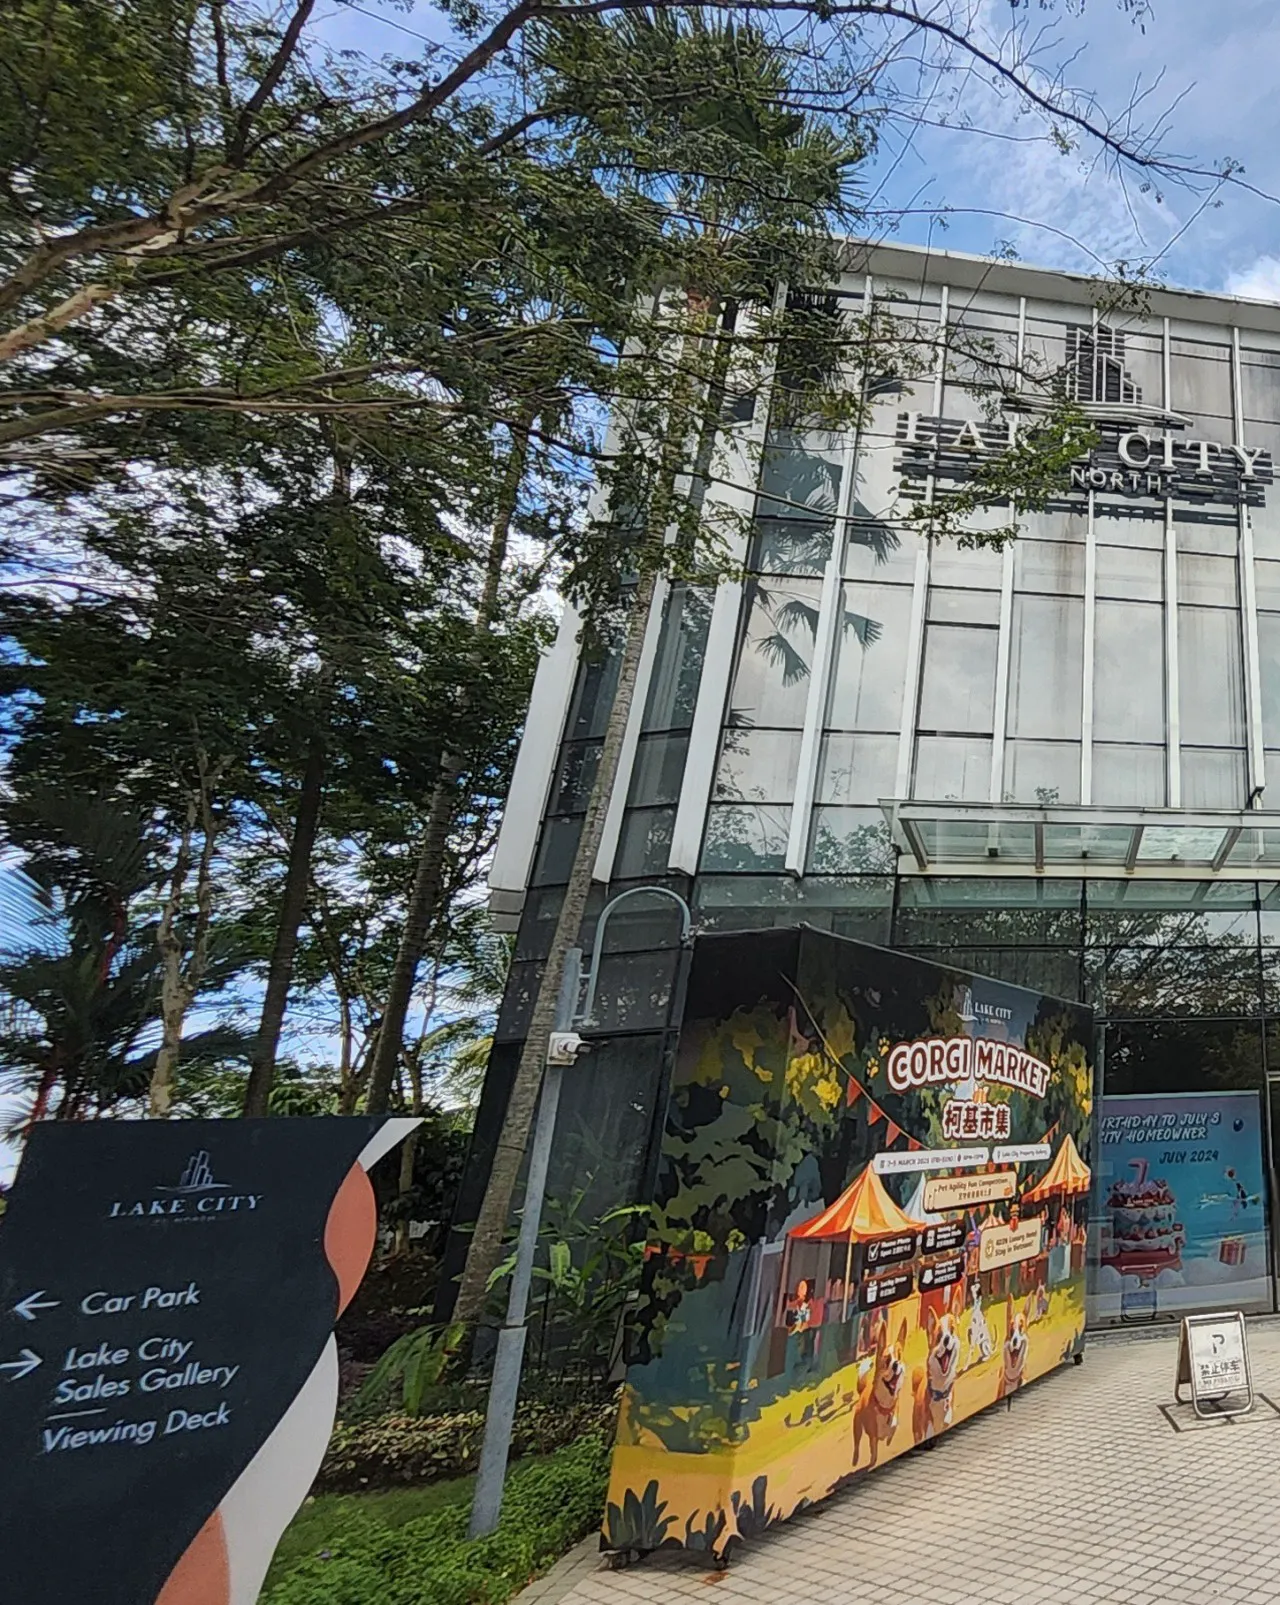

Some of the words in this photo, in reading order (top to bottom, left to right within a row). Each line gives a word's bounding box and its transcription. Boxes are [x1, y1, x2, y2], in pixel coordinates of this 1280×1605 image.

[1118, 432, 1266, 481] CITY
[1070, 468, 1163, 494] NORTH
[974, 1002, 995, 1016] LAKE
[995, 1006, 1013, 1020] CITY
[891, 1040, 969, 1087] CORGI
[975, 1042, 1050, 1096] MARKET
[944, 1104, 1009, 1135] 柯基市集
[1101, 1114, 1158, 1128] IRTHDAY
[1162, 1114, 1177, 1127] TO
[1126, 1127, 1207, 1143] HOMEOWNER
[1159, 1151, 1187, 1165] JULY
[1188, 1149, 1219, 1163] 2024
[108, 1198, 186, 1219] LAKE
[197, 1194, 265, 1213] CITY
[80, 1292, 135, 1316] Car
[141, 1283, 201, 1310] Park
[63, 1342, 129, 1372] Lake
[138, 1337, 194, 1362] City
[53, 1370, 130, 1405] Sales
[139, 1363, 240, 1393] Gallery
[40, 1420, 158, 1455] Viewing
[162, 1402, 232, 1436] Deck
